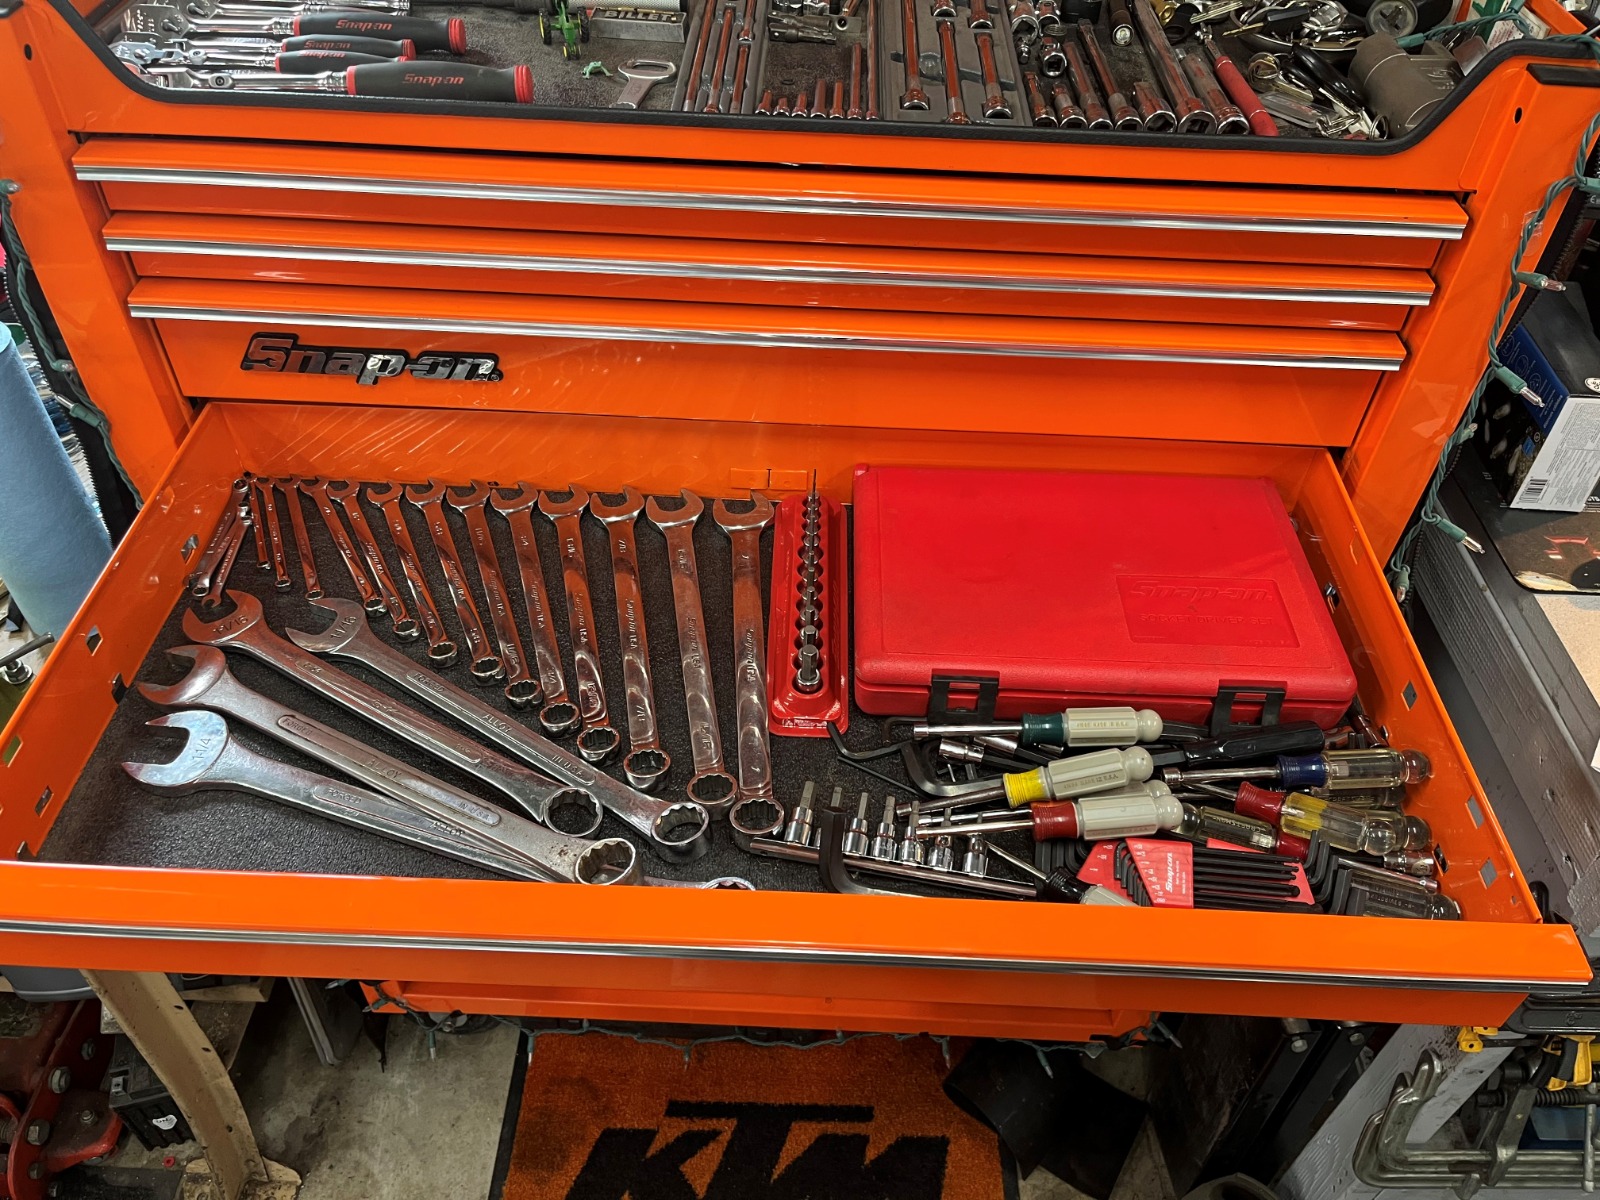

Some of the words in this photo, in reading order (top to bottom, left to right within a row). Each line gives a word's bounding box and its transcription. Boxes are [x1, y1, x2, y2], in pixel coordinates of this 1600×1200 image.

[604, 10, 672, 21] BILLET
[241, 332, 503, 385] Snap-on
[482, 713, 512, 733] ALLOY
[192, 738, 212, 762] 1-1/4
